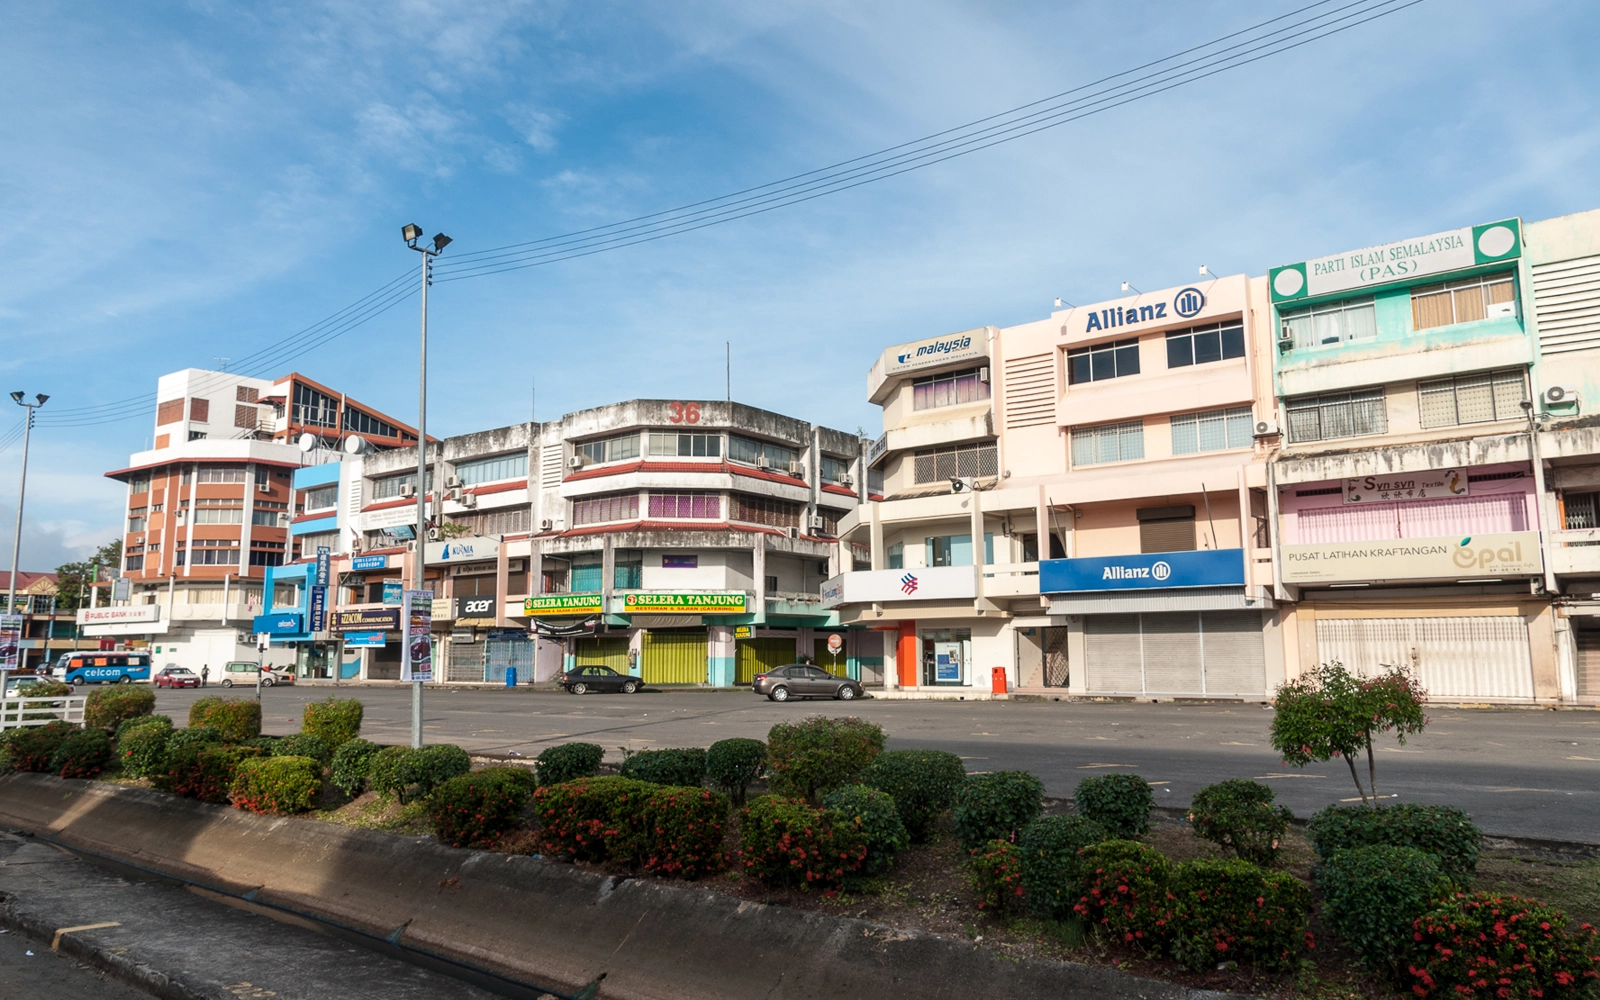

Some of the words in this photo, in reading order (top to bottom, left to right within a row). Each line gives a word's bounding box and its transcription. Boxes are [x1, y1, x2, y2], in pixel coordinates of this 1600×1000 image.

[1314, 258, 1345, 276] PARTI
[1350, 249, 1385, 269] ISLAM
[1389, 235, 1464, 261] SEMALAYSIA
[1360, 259, 1418, 281] (PAS)
[1086, 302, 1167, 333] Allianz
[916, 335, 971, 357] malaysia
[669, 402, 701, 424] 36
[1363, 476, 1390, 491] Syn
[1394, 480, 1415, 490] syn
[1421, 481, 1444, 489] Textile
[452, 544, 474, 555] KURNIA
[1288, 552, 1320, 562] PUSAT
[1323, 549, 1368, 560] LATIHAN
[1370, 546, 1447, 557] KRAFTANGAN
[1102, 565, 1150, 580] Allianz
[465, 600, 493, 613] acer
[533, 598, 562, 608] SELERA
[563, 596, 601, 607] TANJUNG
[638, 595, 684, 605] SELERA
[687, 595, 743, 605] TANJUNG
[314, 594, 322, 632] SAMSUNG
[84, 668, 121, 677] celcom
